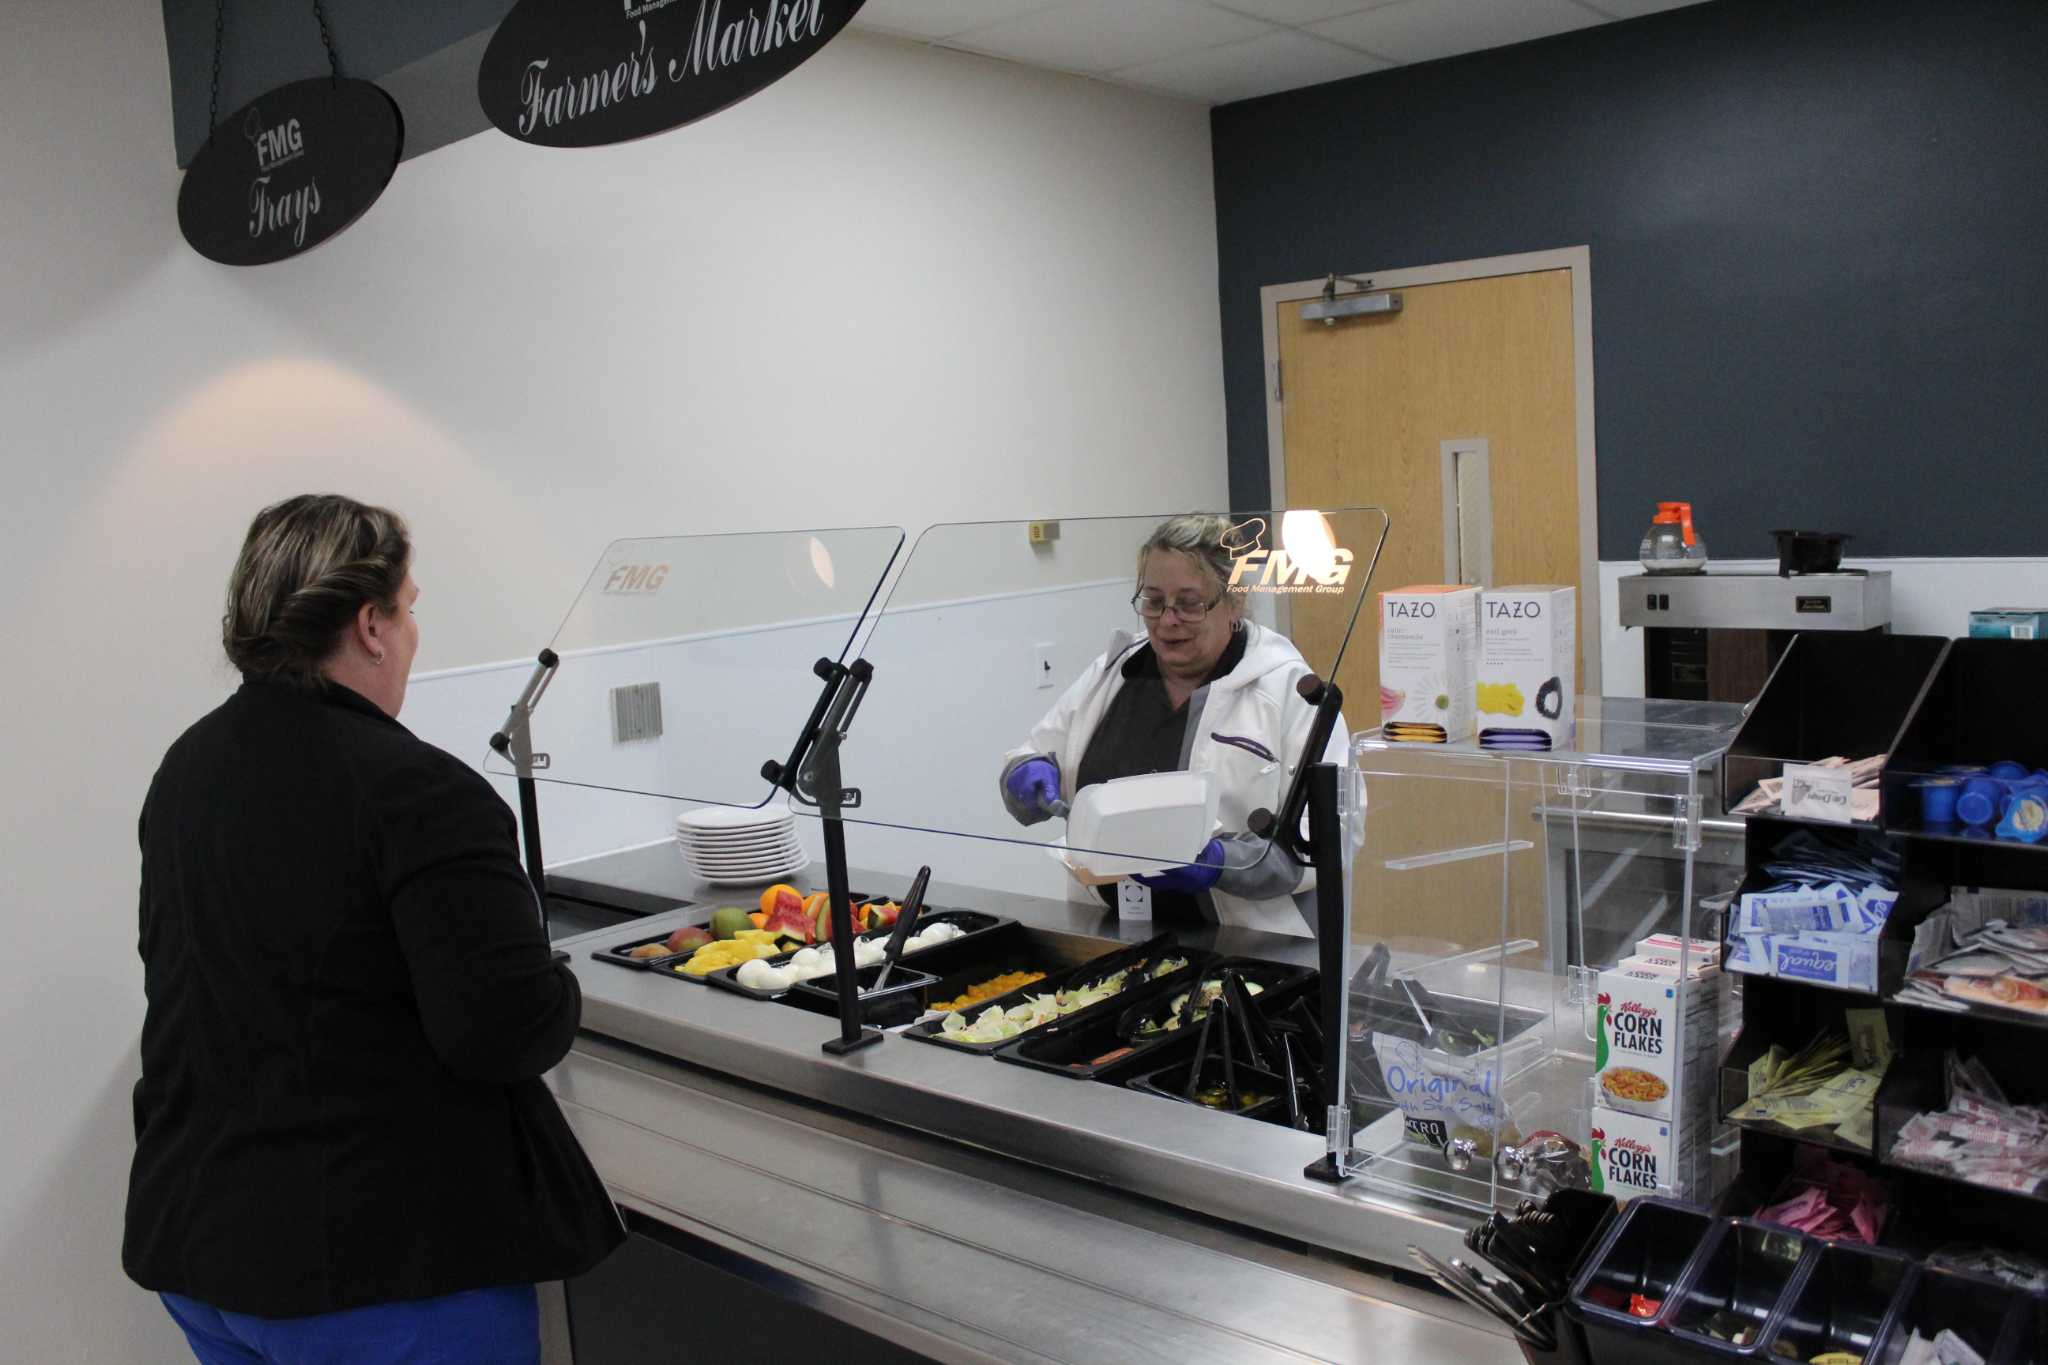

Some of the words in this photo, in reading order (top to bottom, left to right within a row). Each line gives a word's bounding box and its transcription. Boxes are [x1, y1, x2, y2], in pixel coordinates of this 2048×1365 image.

[518, 19, 657, 135] Farmer's
[256, 118, 303, 167] FMG
[249, 176, 321, 247] Trays
[603, 565, 669, 591] FMG
[1226, 584, 1249, 593] Food
[1250, 584, 1314, 594] Management
[1315, 584, 1345, 595] Group
[1387, 601, 1436, 618] TAZO
[1486, 601, 1541, 618] TAZO
[1779, 951, 1838, 971] equal
[1614, 1012, 1662, 1037] CORN
[1614, 1031, 1663, 1055] FLAKES
[1387, 1065, 1492, 1102] Original
[1608, 1147, 1657, 1173] CORN
[1608, 1165, 1657, 1190] FLAKES
